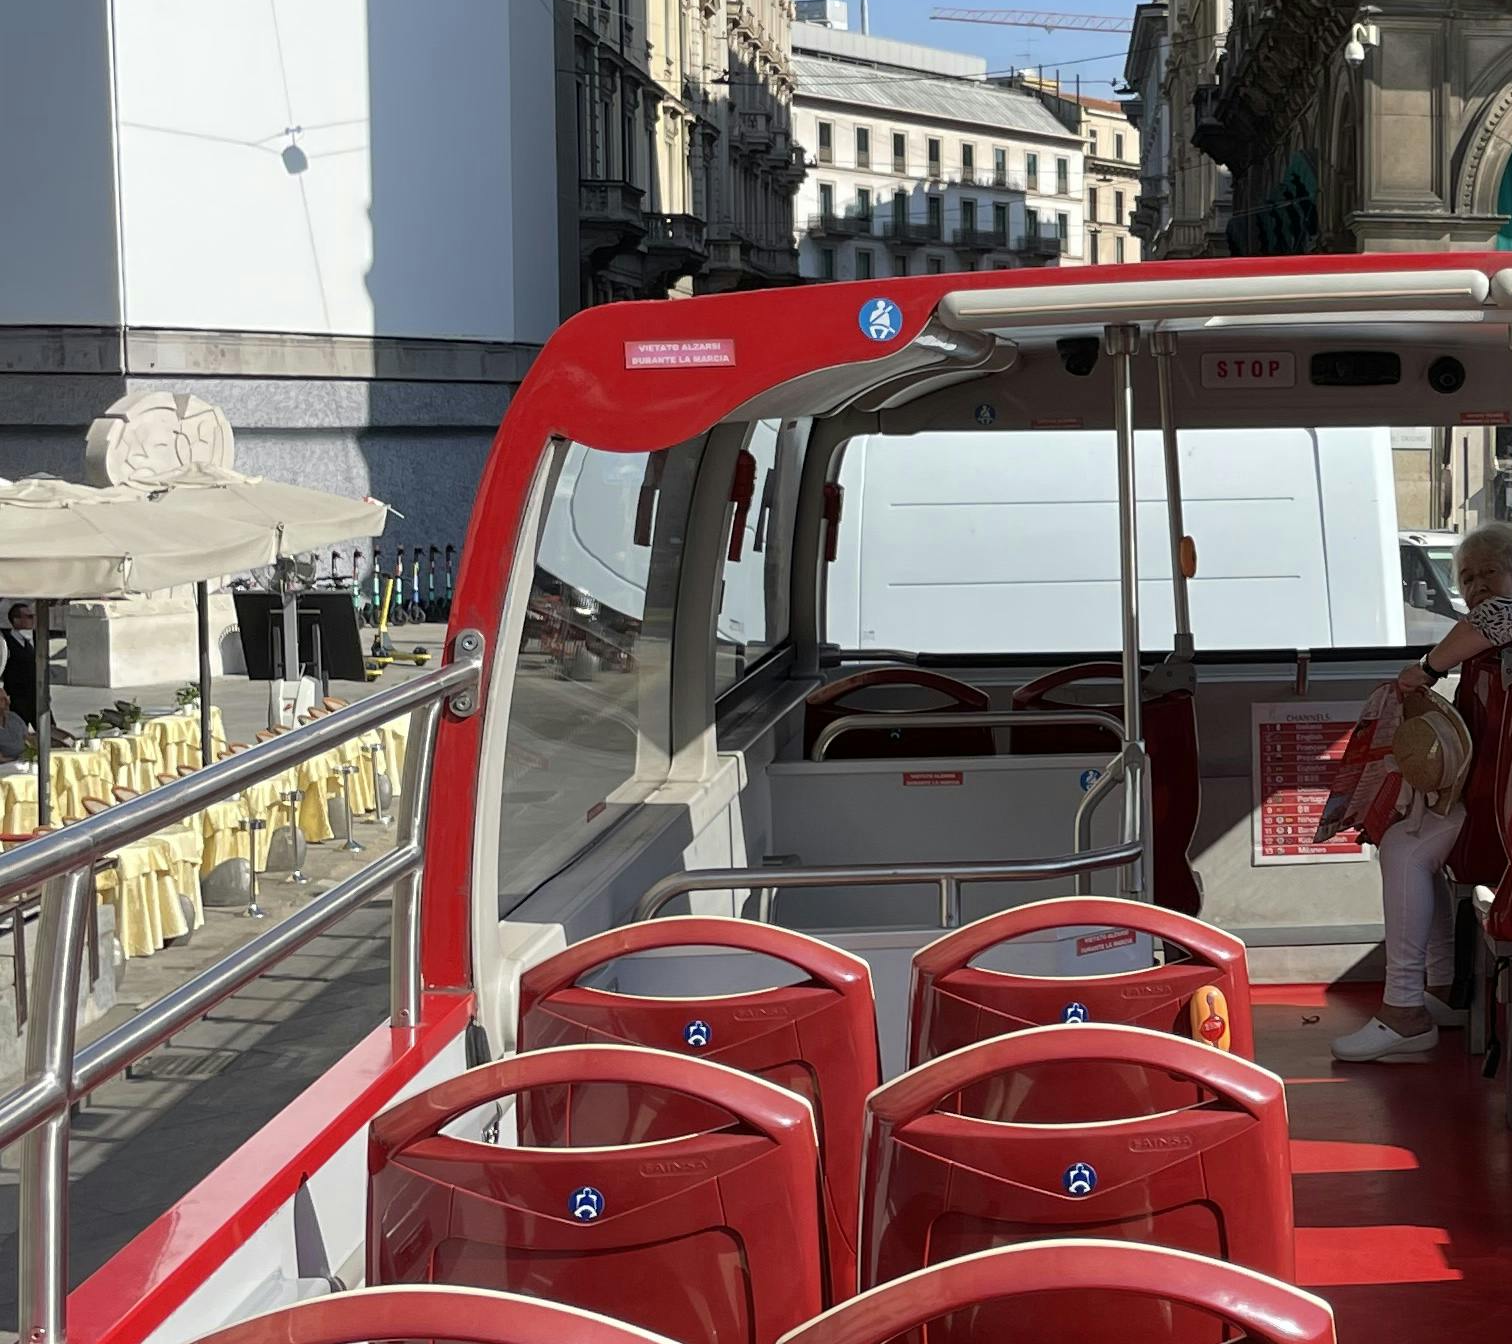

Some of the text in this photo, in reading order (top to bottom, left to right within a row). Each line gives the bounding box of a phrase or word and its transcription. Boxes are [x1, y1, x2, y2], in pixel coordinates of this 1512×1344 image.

[638, 342, 721, 353] VIETATO ALZARSI
[631, 355, 677, 365] DURANTE
[679, 355, 692, 363] LA
[1216, 360, 1280, 378] STOP
